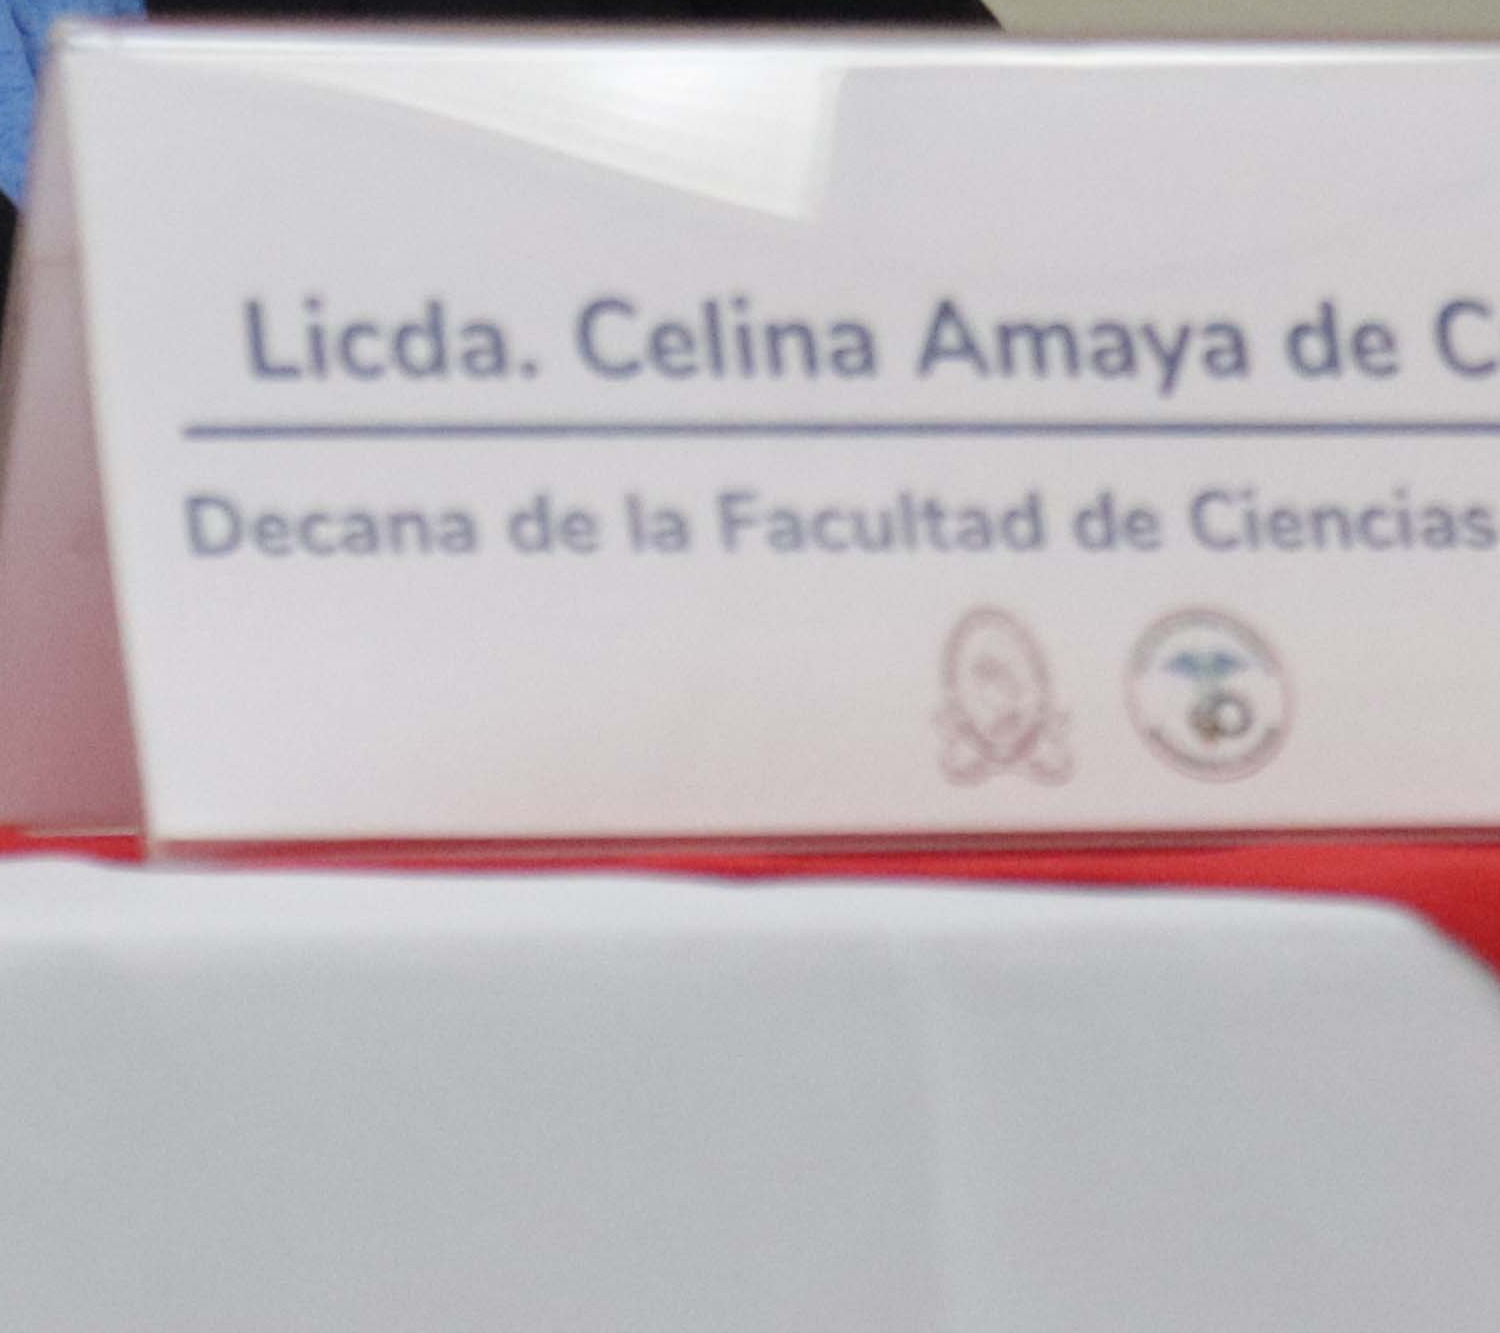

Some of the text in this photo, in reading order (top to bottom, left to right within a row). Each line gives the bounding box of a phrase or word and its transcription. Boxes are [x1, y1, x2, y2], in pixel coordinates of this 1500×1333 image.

[242, 294, 539, 382] Licda.
[572, 293, 880, 382] Celina
[914, 295, 1253, 399] Amaya
[1282, 295, 1401, 381] de
[181, 489, 481, 560] Decana
[505, 489, 601, 556] de
[623, 489, 694, 555] la
[714, 486, 1050, 555] Facultad
[1069, 487, 1164, 554] de
